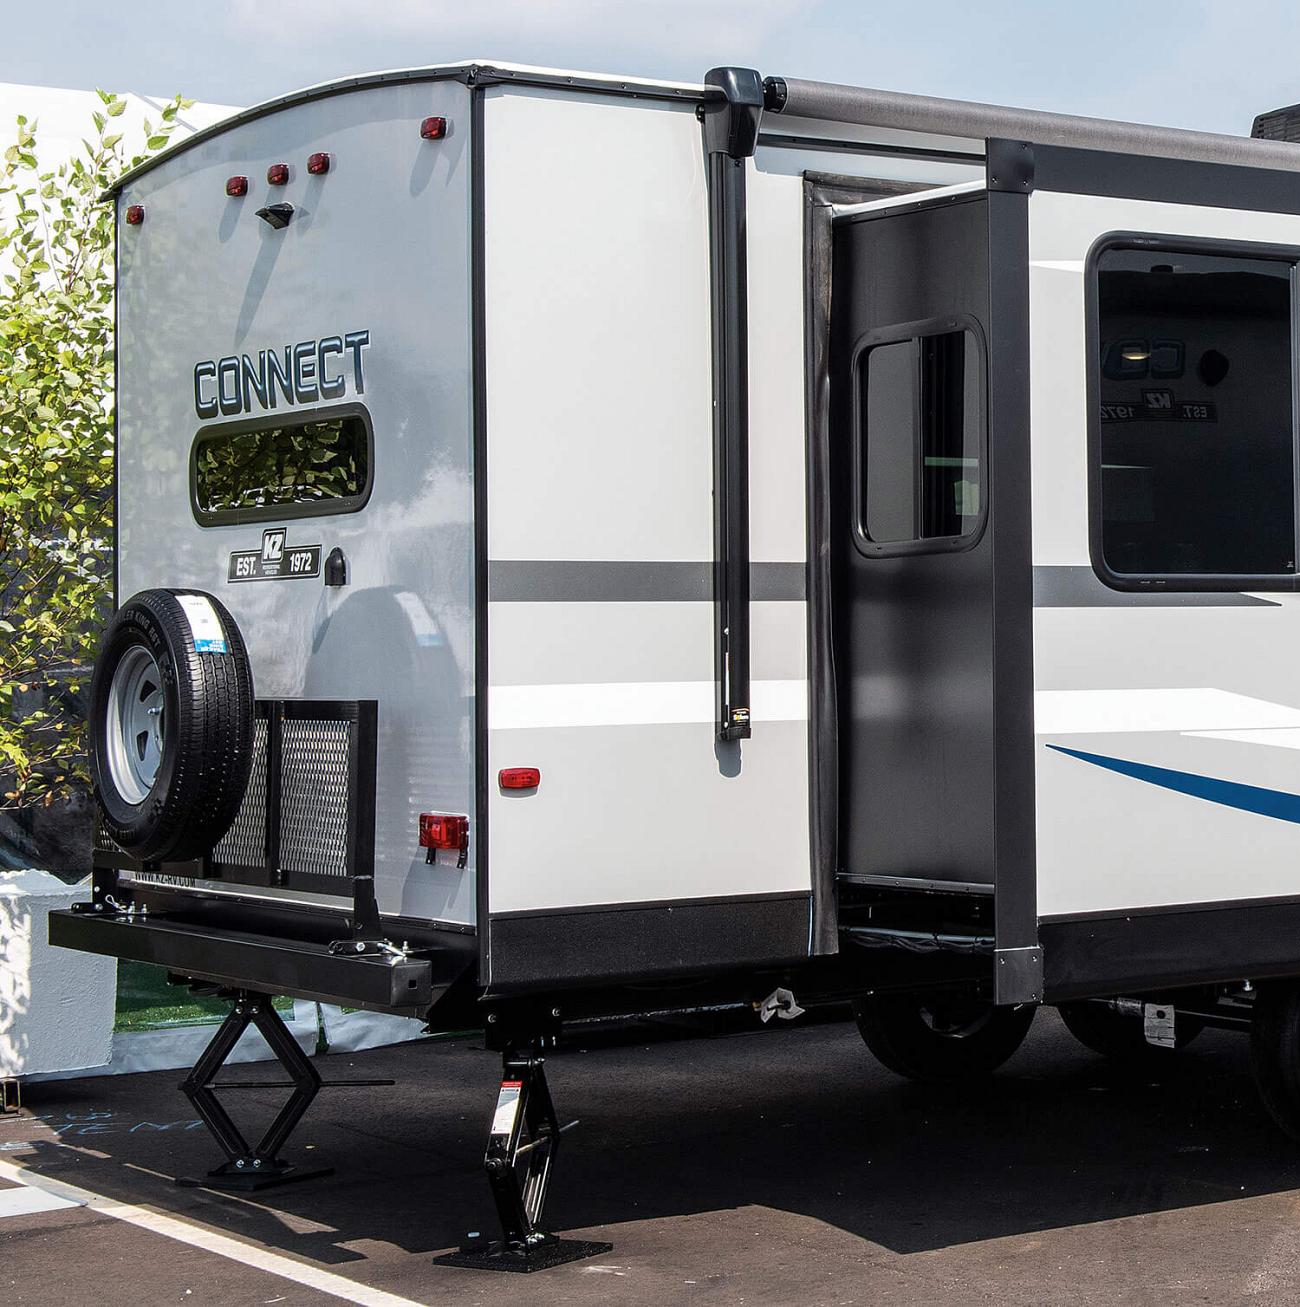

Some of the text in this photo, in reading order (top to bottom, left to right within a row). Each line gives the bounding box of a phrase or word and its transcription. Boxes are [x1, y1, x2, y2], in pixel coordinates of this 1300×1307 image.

[194, 329, 370, 420] CONNECT
[263, 534, 283, 560] KZ
[236, 556, 257, 576] EST.
[289, 552, 312, 572] 1972
